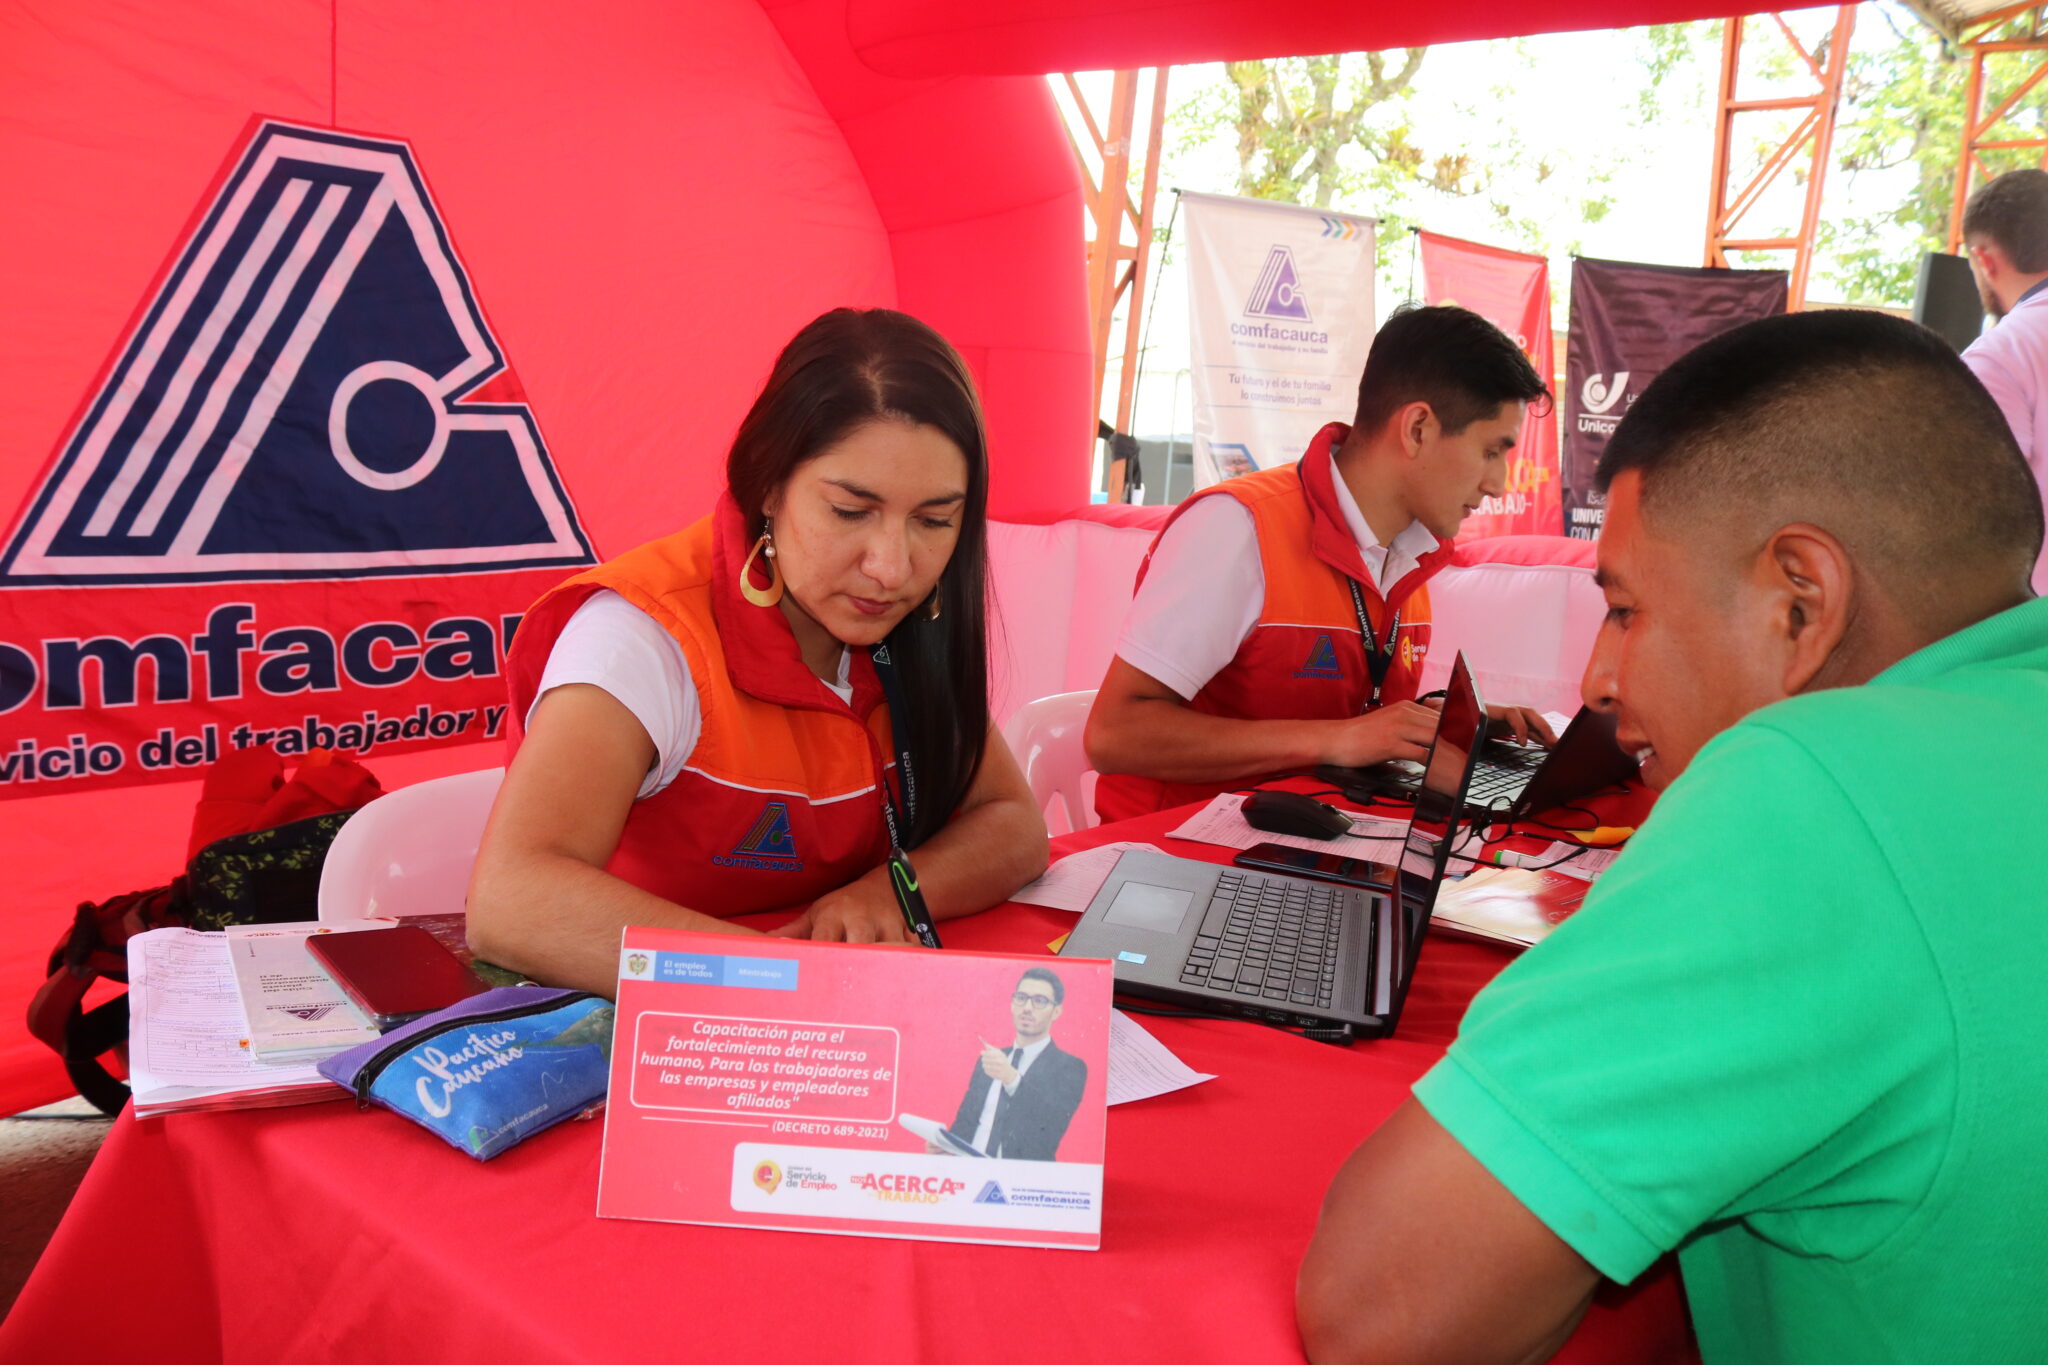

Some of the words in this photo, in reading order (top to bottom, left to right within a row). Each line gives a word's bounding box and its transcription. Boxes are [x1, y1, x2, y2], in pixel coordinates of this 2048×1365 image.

[1231, 323, 1328, 344] comfacauca
[1229, 373, 1240, 384] Tu
[1265, 379, 1270, 390] y
[1272, 377, 1280, 388] el
[1281, 378, 1291, 389] de
[1293, 380, 1301, 389] tu
[1303, 380, 1331, 391] familia
[1241, 389, 1249, 400] lo
[1251, 392, 1295, 405] construimos
[1578, 419, 1615, 433] Unico
[138, 723, 219, 770] del
[229, 704, 476, 756] trabajador
[483, 704, 509, 738] y
[712, 855, 803, 872] comfacauca
[664, 960, 672, 969] El
[674, 961, 706, 971] empleo
[675, 969, 687, 977] de
[688, 969, 713, 979] todos
[693, 1021, 788, 1040] Capacitación
[791, 1029, 826, 1043] para
[830, 1030, 845, 1044] el
[666, 1035, 781, 1057] fortalecimiento
[785, 1043, 808, 1059] del
[811, 1049, 867, 1063] recurso
[640, 1052, 705, 1071] humano,
[709, 1057, 744, 1072] Para
[747, 1059, 770, 1074] los
[773, 1060, 869, 1081] trabajadores
[873, 1067, 892, 1082] de
[416, 1047, 523, 1118] Caucano
[660, 1070, 681, 1085] las
[685, 1074, 757, 1092] empresas
[759, 1079, 769, 1093] y
[772, 1079, 869, 1098] empleadores
[727, 1093, 800, 1110] afiliados"
[498, 1103, 549, 1135] comfacauca
[771, 1120, 830, 1135] (DECRETO
[833, 1125, 889, 1140] 689-2021)
[786, 1179, 799, 1189] de
[800, 1179, 837, 1191] Empleo
[787, 1169, 827, 1183] Servicio
[861, 1173, 956, 1195] ACERCA
[877, 1190, 939, 1204] TRABAJO
[1011, 1194, 1091, 1205] comfacauca
